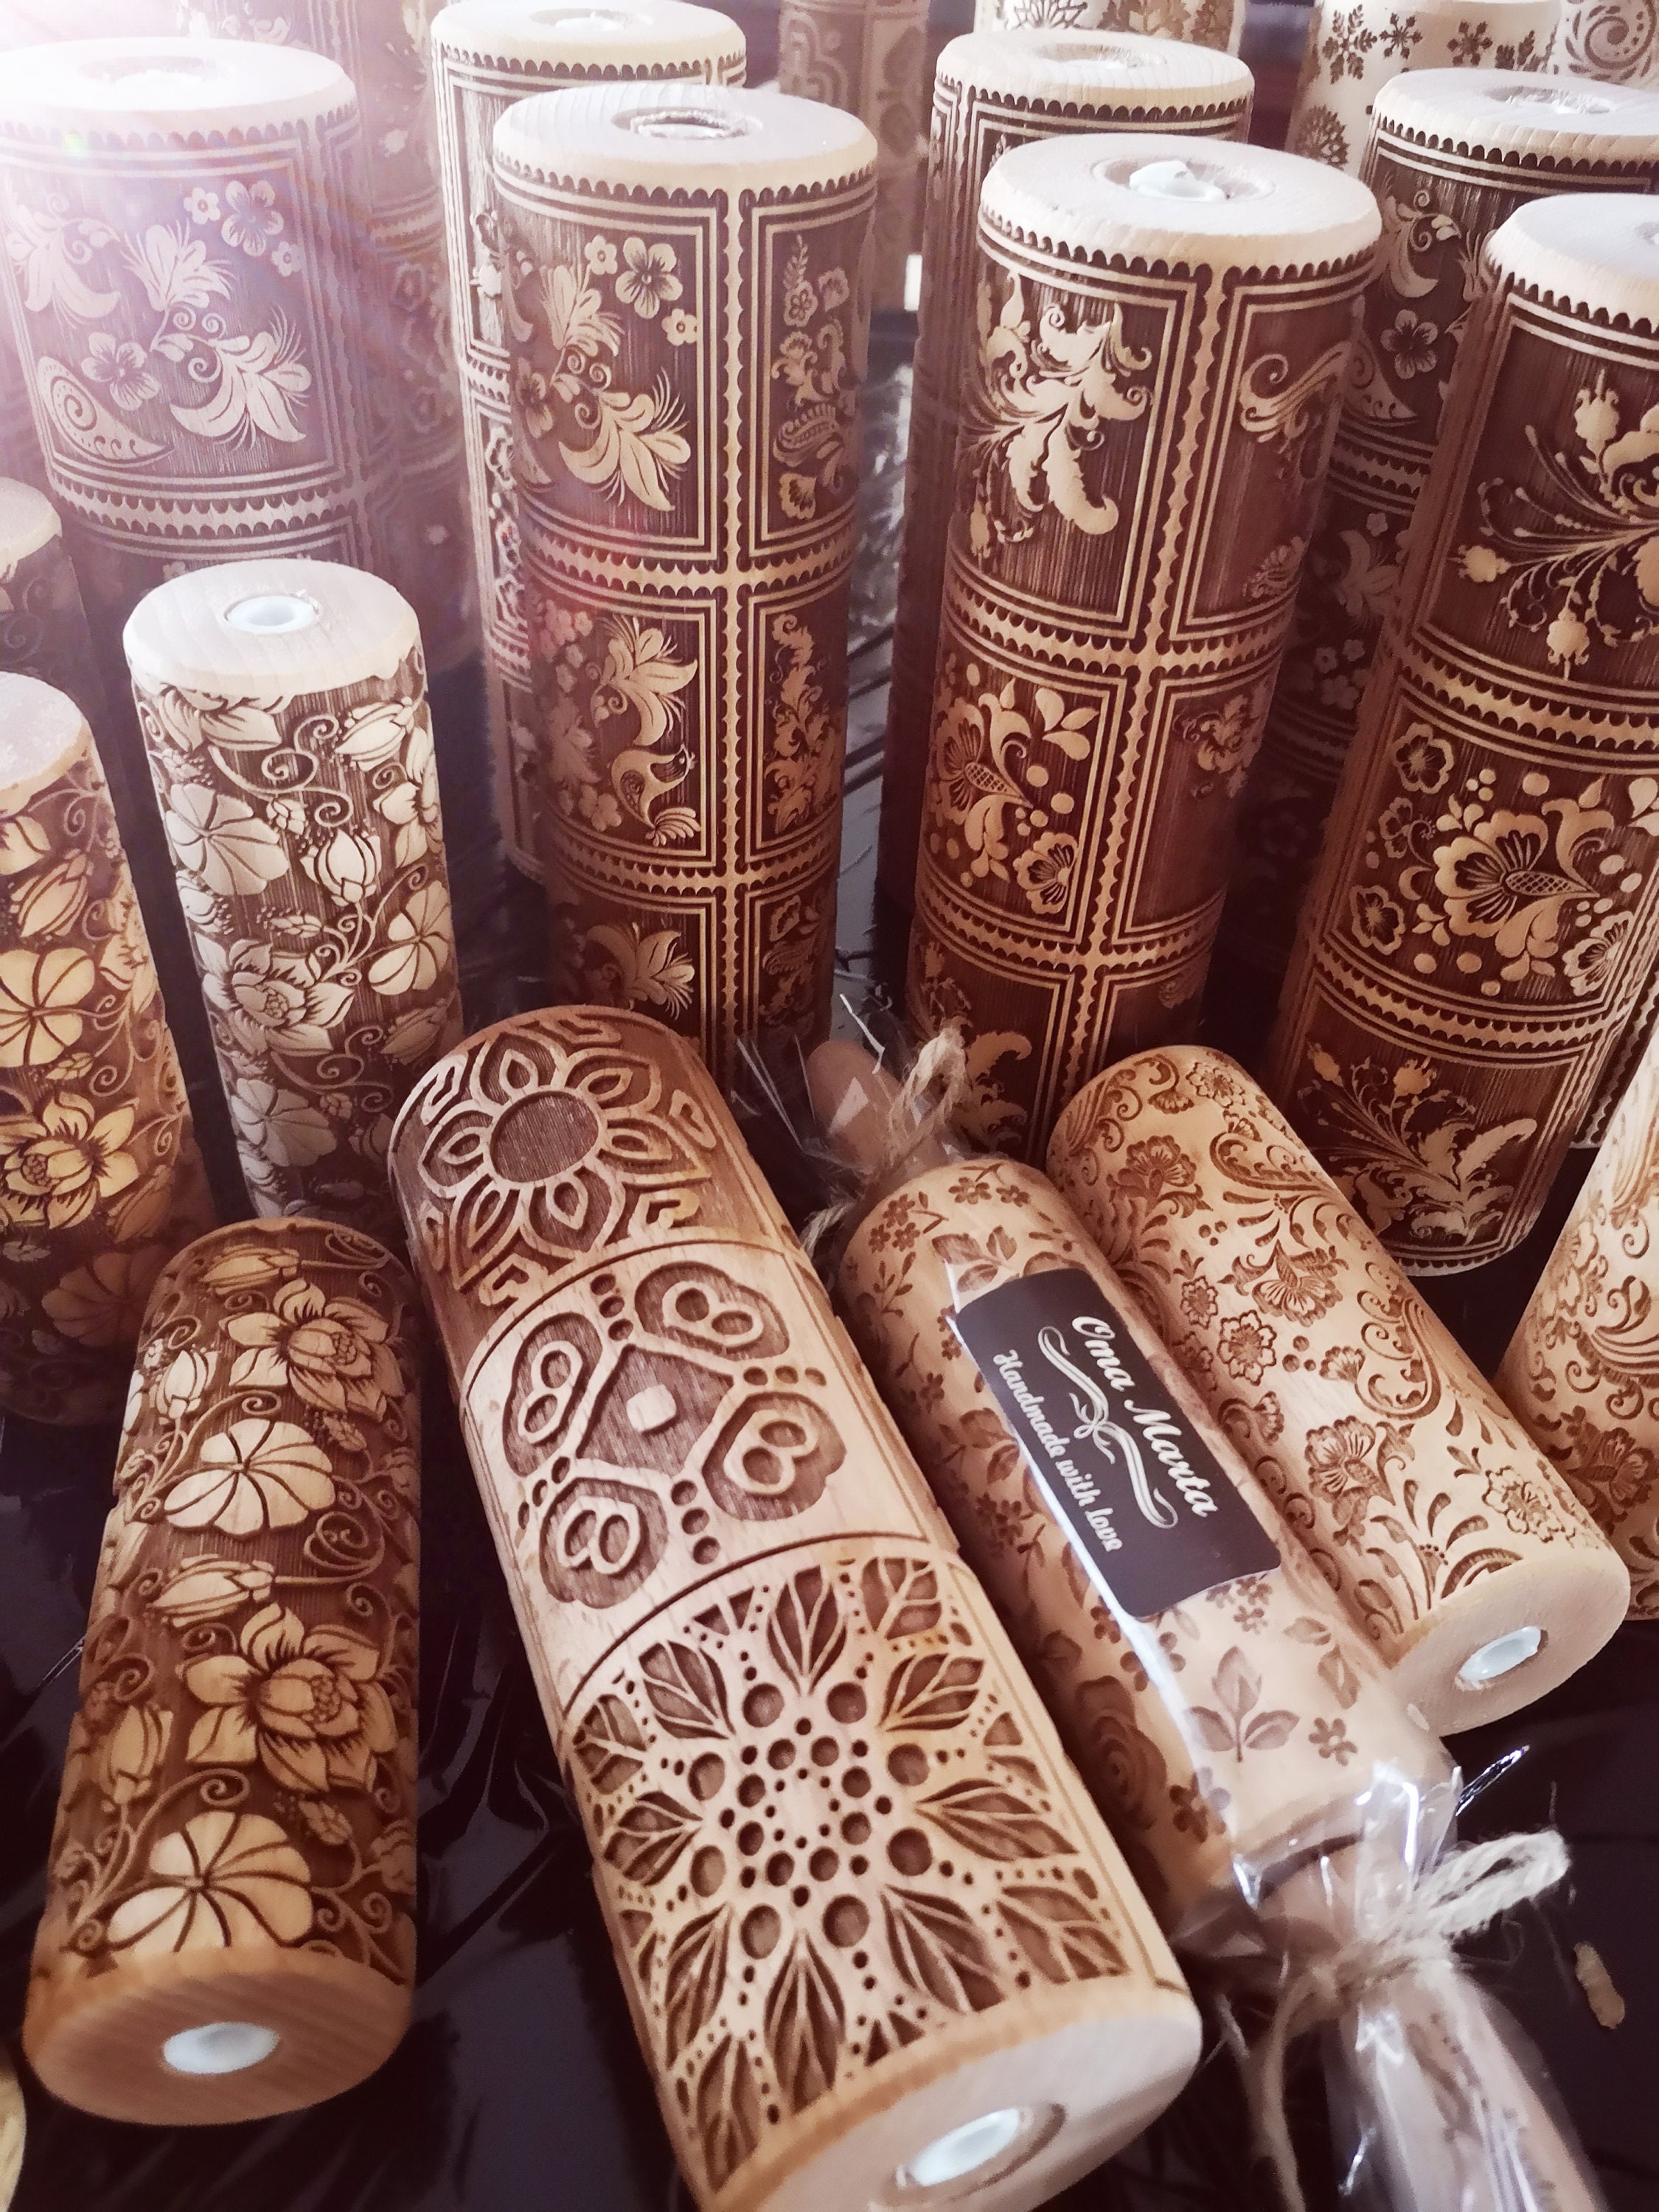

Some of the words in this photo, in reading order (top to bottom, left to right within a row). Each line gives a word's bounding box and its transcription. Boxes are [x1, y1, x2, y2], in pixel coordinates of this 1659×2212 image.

[993, 1349, 1070, 1458] Handmade
[1056, 1458, 1101, 1507] with
[1085, 1508, 1123, 1552] love
[1072, 1317, 1135, 1391] Oma
[1124, 1399, 1218, 1517] Marta
